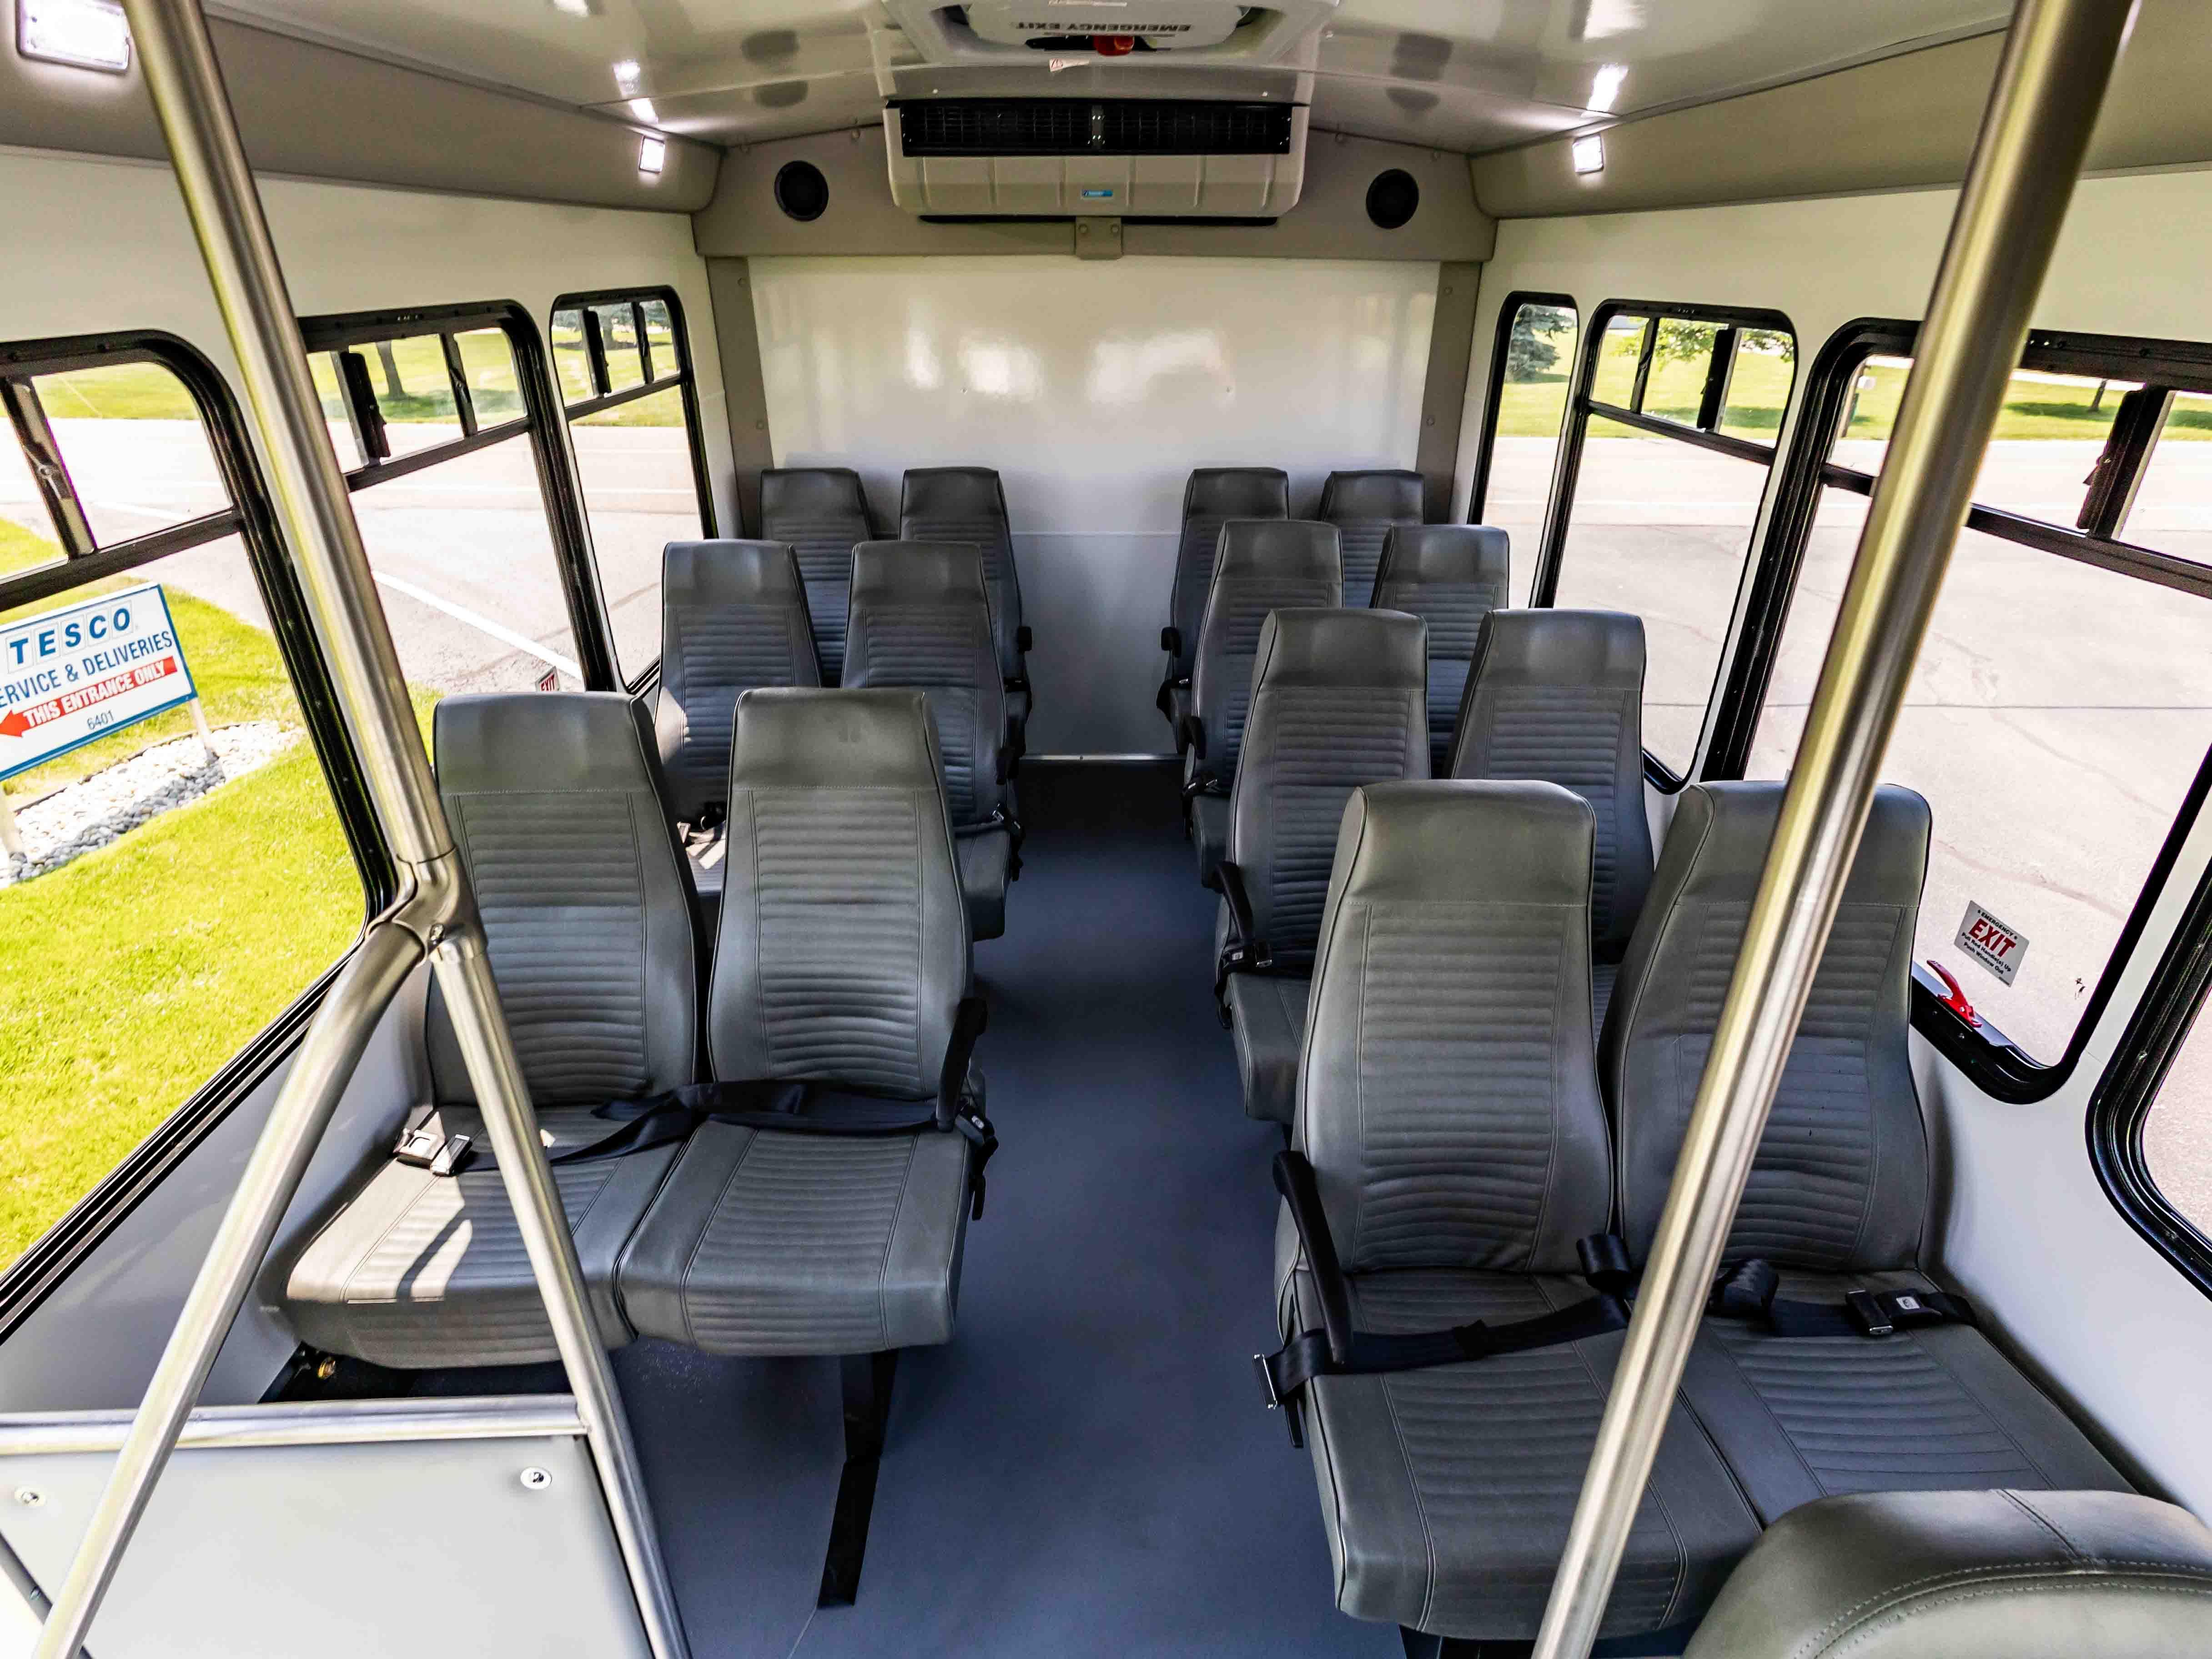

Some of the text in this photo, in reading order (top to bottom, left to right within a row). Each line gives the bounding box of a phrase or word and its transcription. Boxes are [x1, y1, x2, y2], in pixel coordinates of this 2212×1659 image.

[1067, 24, 1191, 32] EMERGENCY
[10, 608, 131, 664] TESCO
[65, 664, 79, 682] &
[82, 631, 172, 676] DELIVERIES
[23, 661, 166, 728] THIS ENTRANCE ONLY
[87, 710, 114, 730] 6401
[1961, 932, 1971, 940] Pull
[1971, 939, 1981, 949] Red
[1968, 918, 2016, 958] EXIT
[1981, 912, 2014, 937] EMERGENCY
[1964, 942, 2004, 974] Push Window Out
